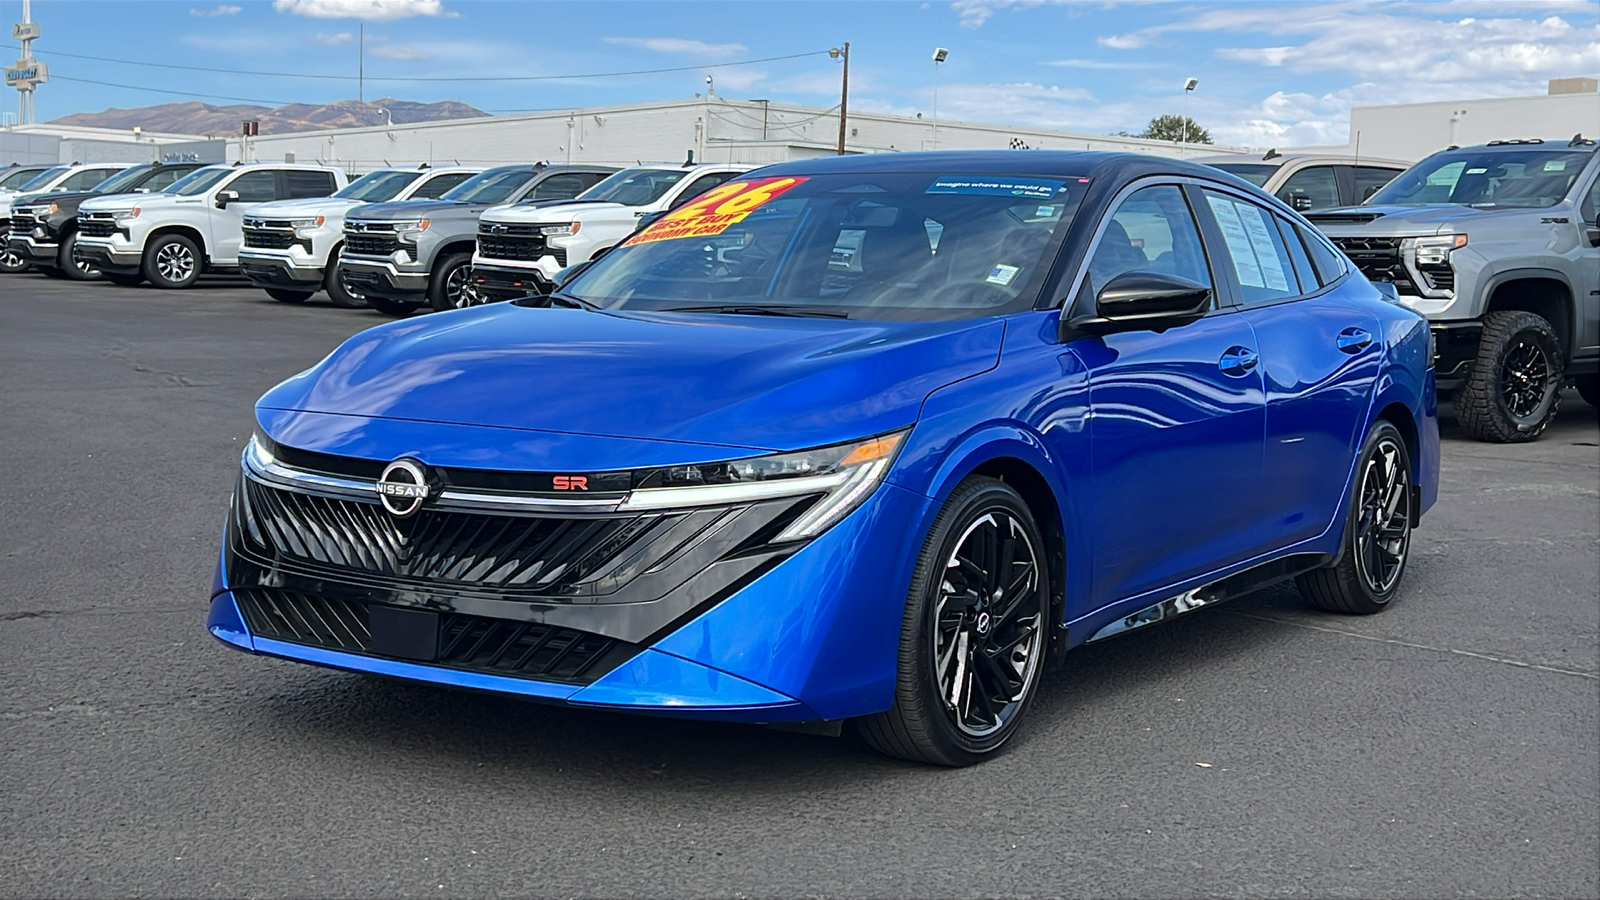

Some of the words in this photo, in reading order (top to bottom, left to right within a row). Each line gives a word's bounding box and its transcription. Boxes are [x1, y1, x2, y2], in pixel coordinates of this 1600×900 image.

[646, 217, 699, 233] BEST
[695, 212, 745, 226] BUY
[624, 226, 697, 246] ECONOMY
[691, 223, 729, 235] CAR
[376, 483, 428, 498] NISSAN
[552, 475, 588, 491] SR
